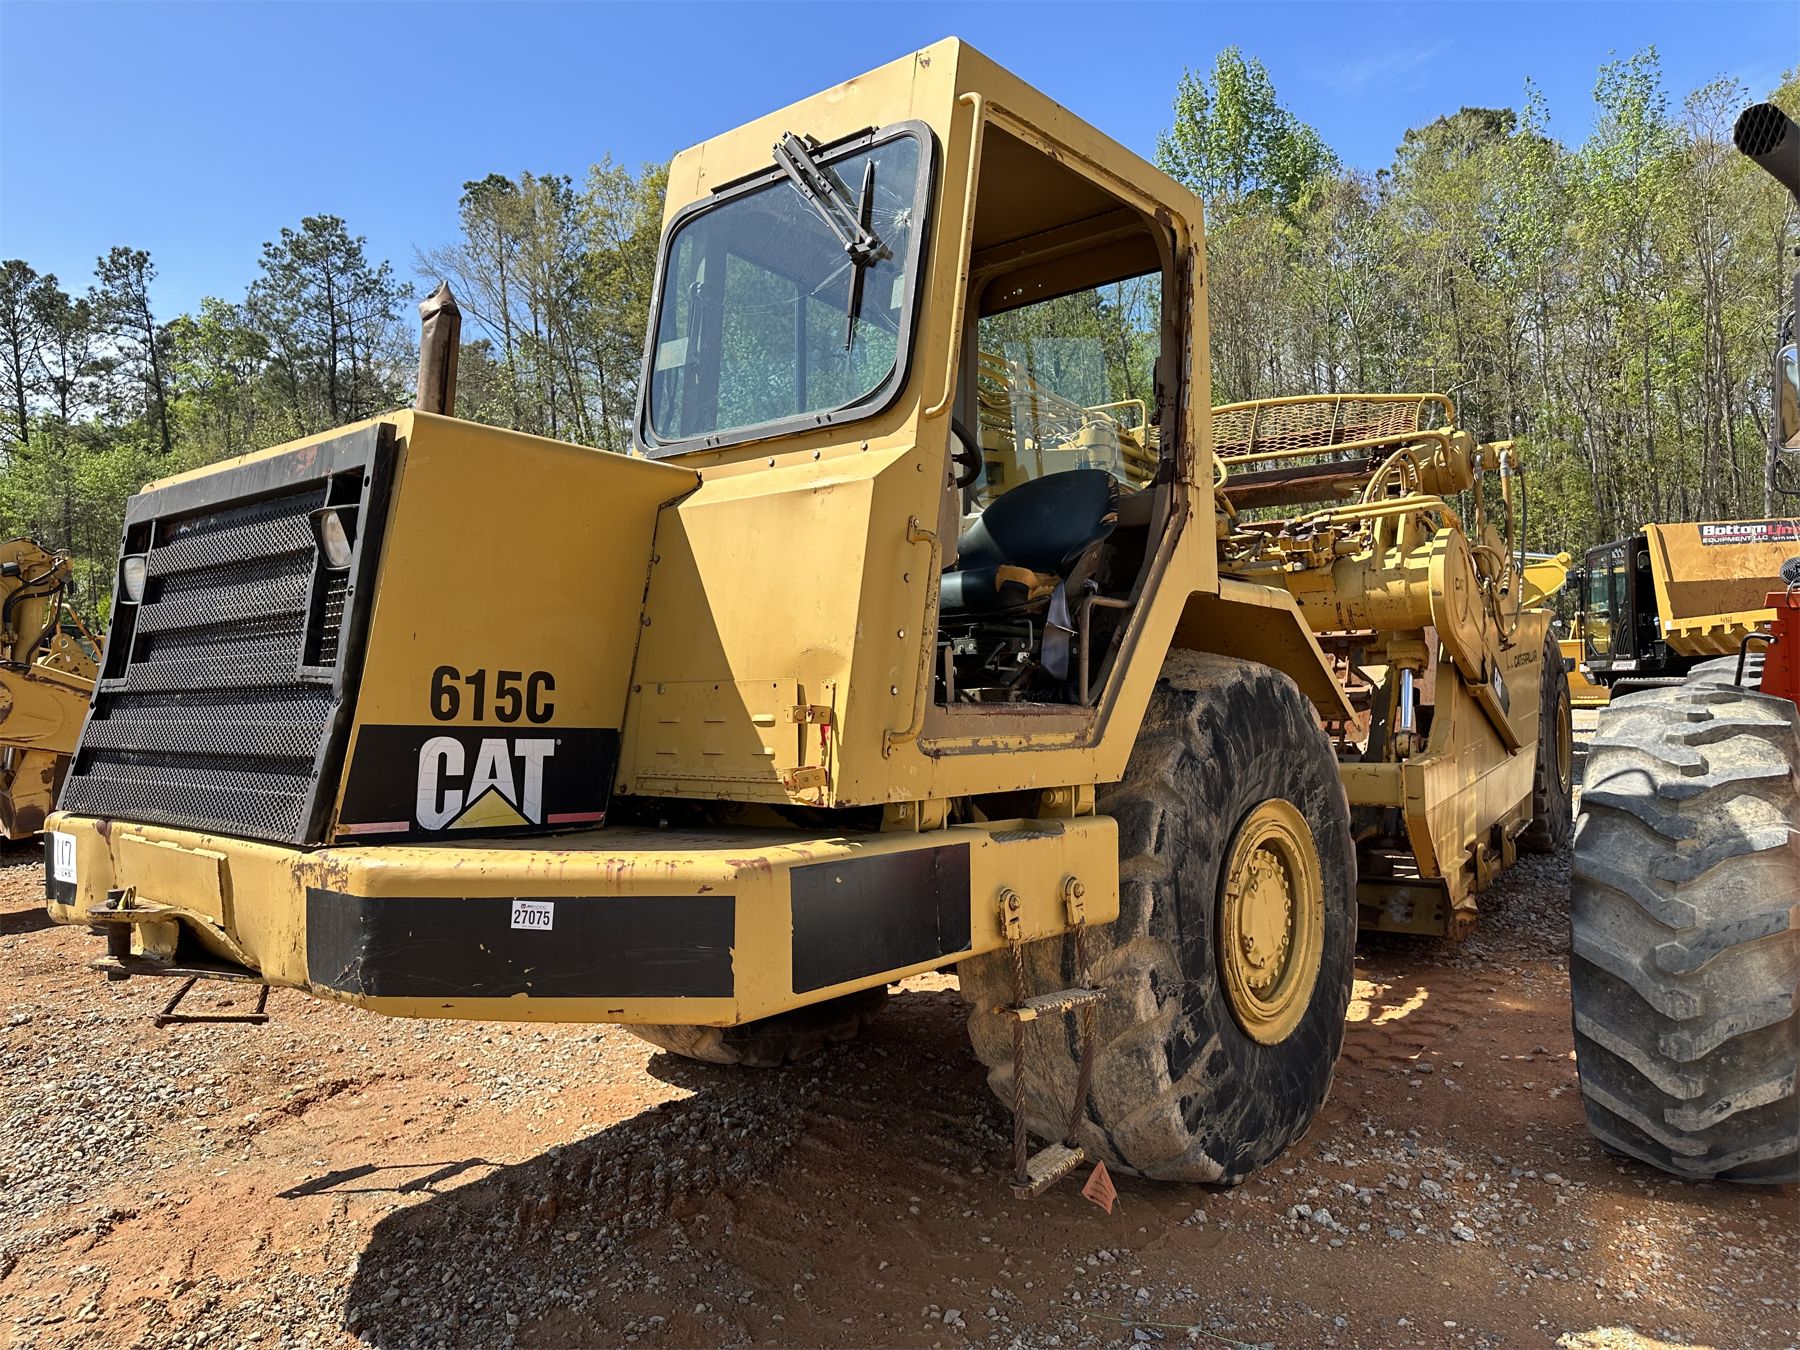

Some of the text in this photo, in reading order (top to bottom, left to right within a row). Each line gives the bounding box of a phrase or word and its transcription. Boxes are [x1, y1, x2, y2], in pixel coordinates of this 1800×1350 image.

[430, 665, 556, 724] 615C
[415, 736, 556, 831] CAT
[513, 909, 550, 926] 27075
